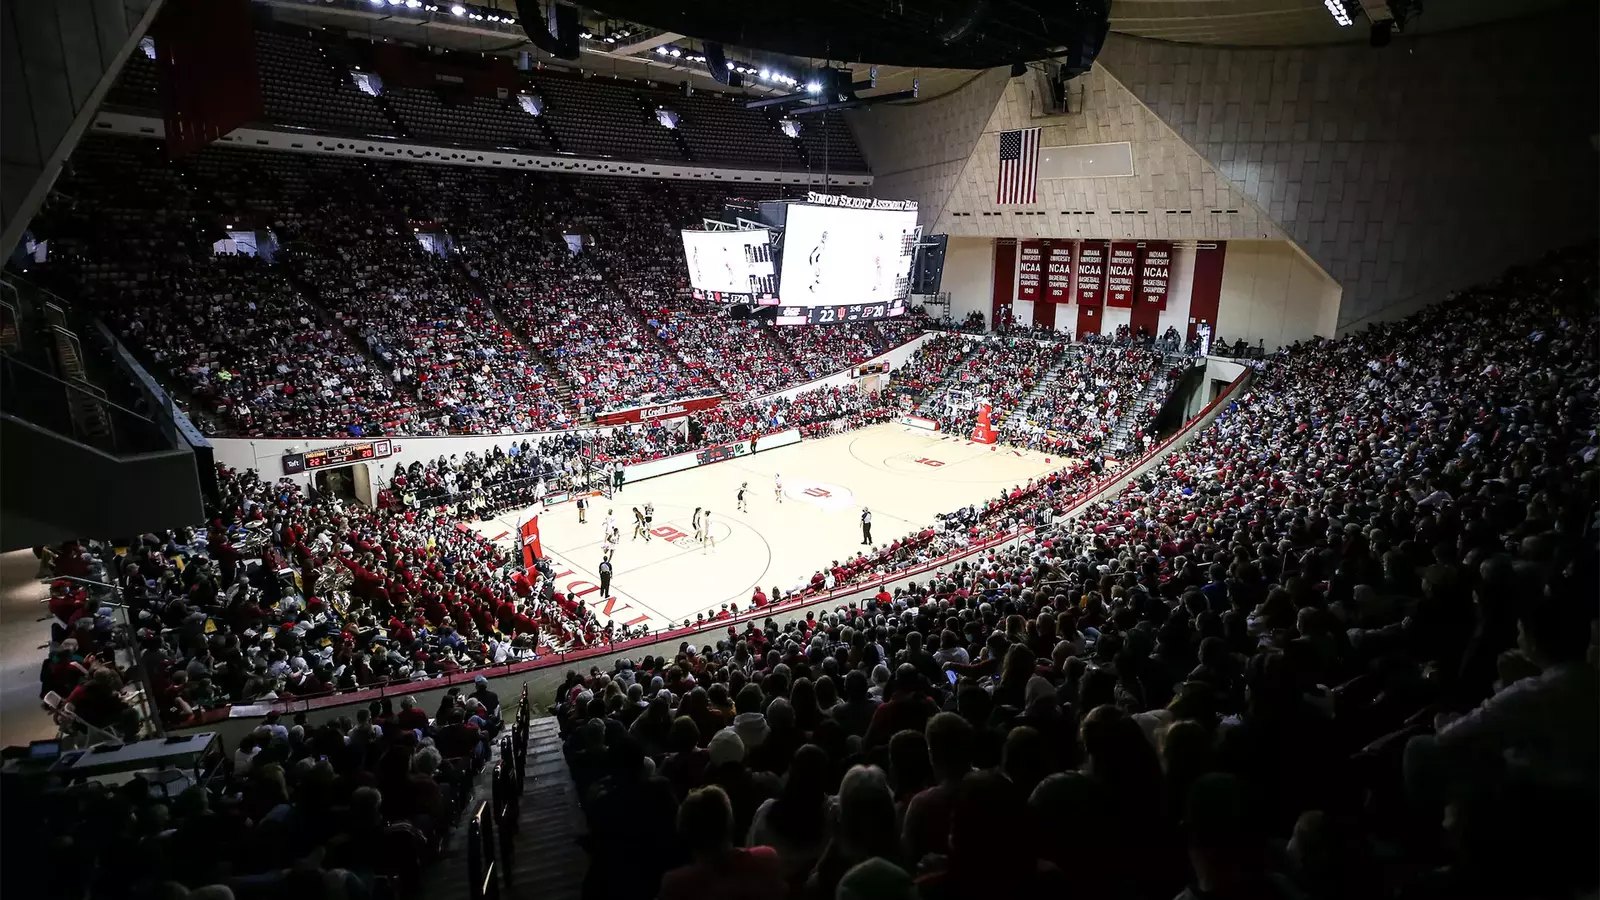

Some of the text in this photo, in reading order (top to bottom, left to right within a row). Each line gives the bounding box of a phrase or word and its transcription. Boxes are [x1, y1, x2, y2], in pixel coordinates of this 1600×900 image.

[807, 191, 840, 205] SIMON
[1020, 263, 1040, 272] NCAA
[1049, 264, 1070, 273] NCAA
[1079, 265, 1101, 274] NCAA
[1110, 266, 1134, 276] NCAA
[1143, 268, 1168, 278] NCAA
[819, 310, 834, 322] 22
[873, 306, 884, 317] 20
[648, 406, 666, 416] Credit
[334, 448, 350, 457] 5:45
[310, 458, 320, 466] 22
